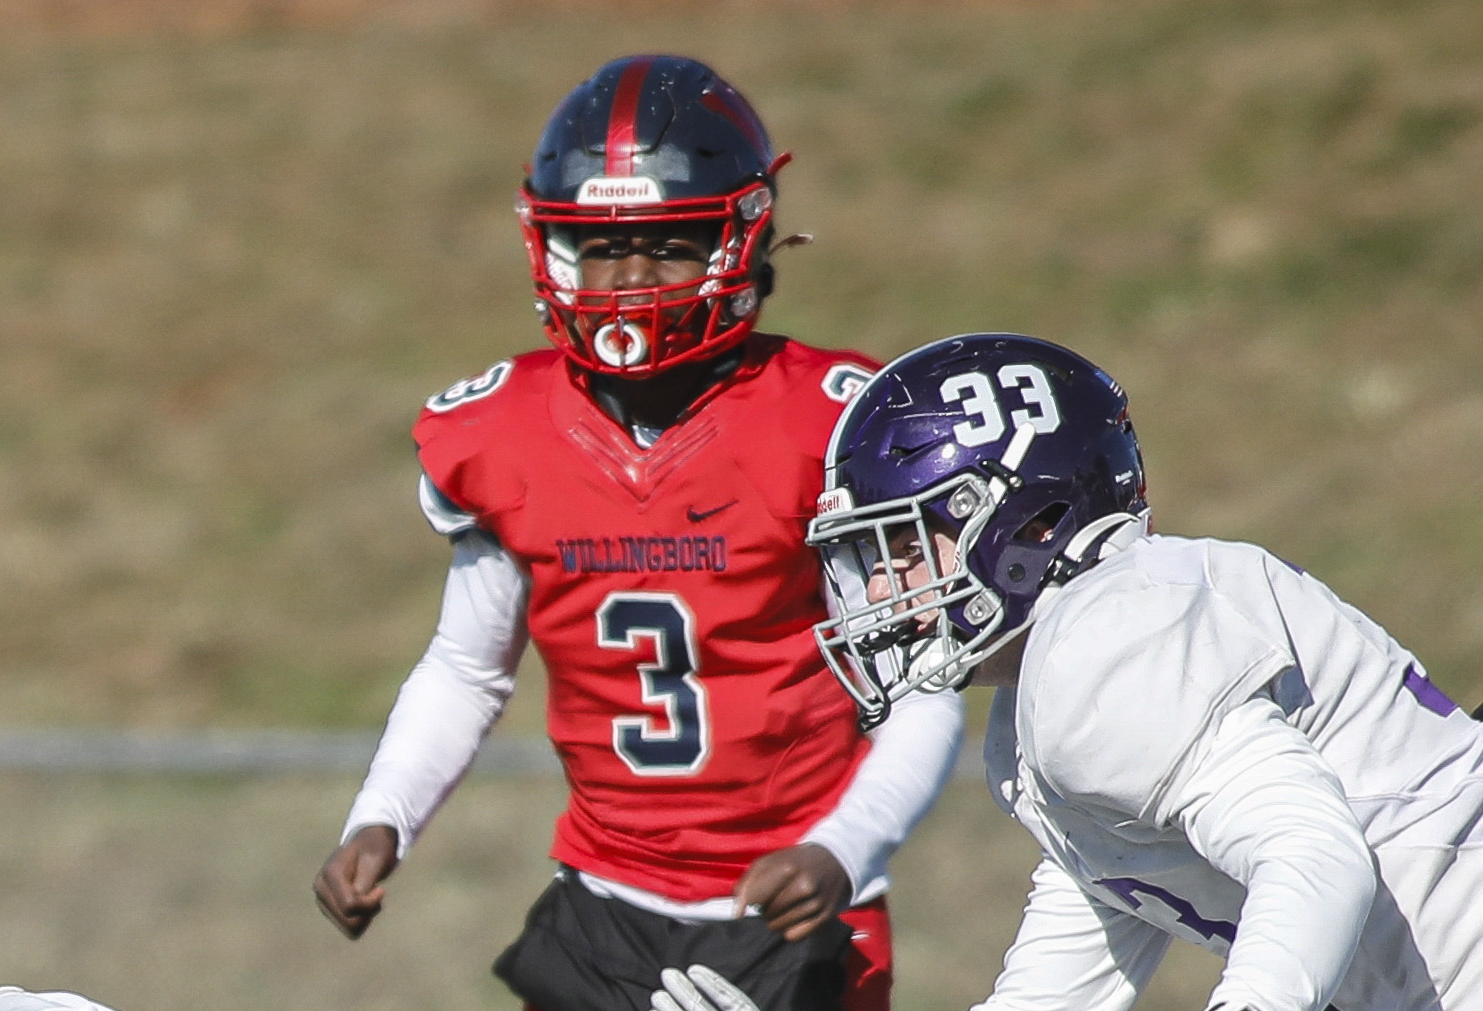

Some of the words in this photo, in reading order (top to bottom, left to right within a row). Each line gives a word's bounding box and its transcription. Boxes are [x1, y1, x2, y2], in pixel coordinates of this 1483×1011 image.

[587, 184, 649, 198] Riddell
[939, 364, 1061, 448] 33
[556, 536, 727, 573] WILLINGBORO
[595, 591, 710, 776] 3
